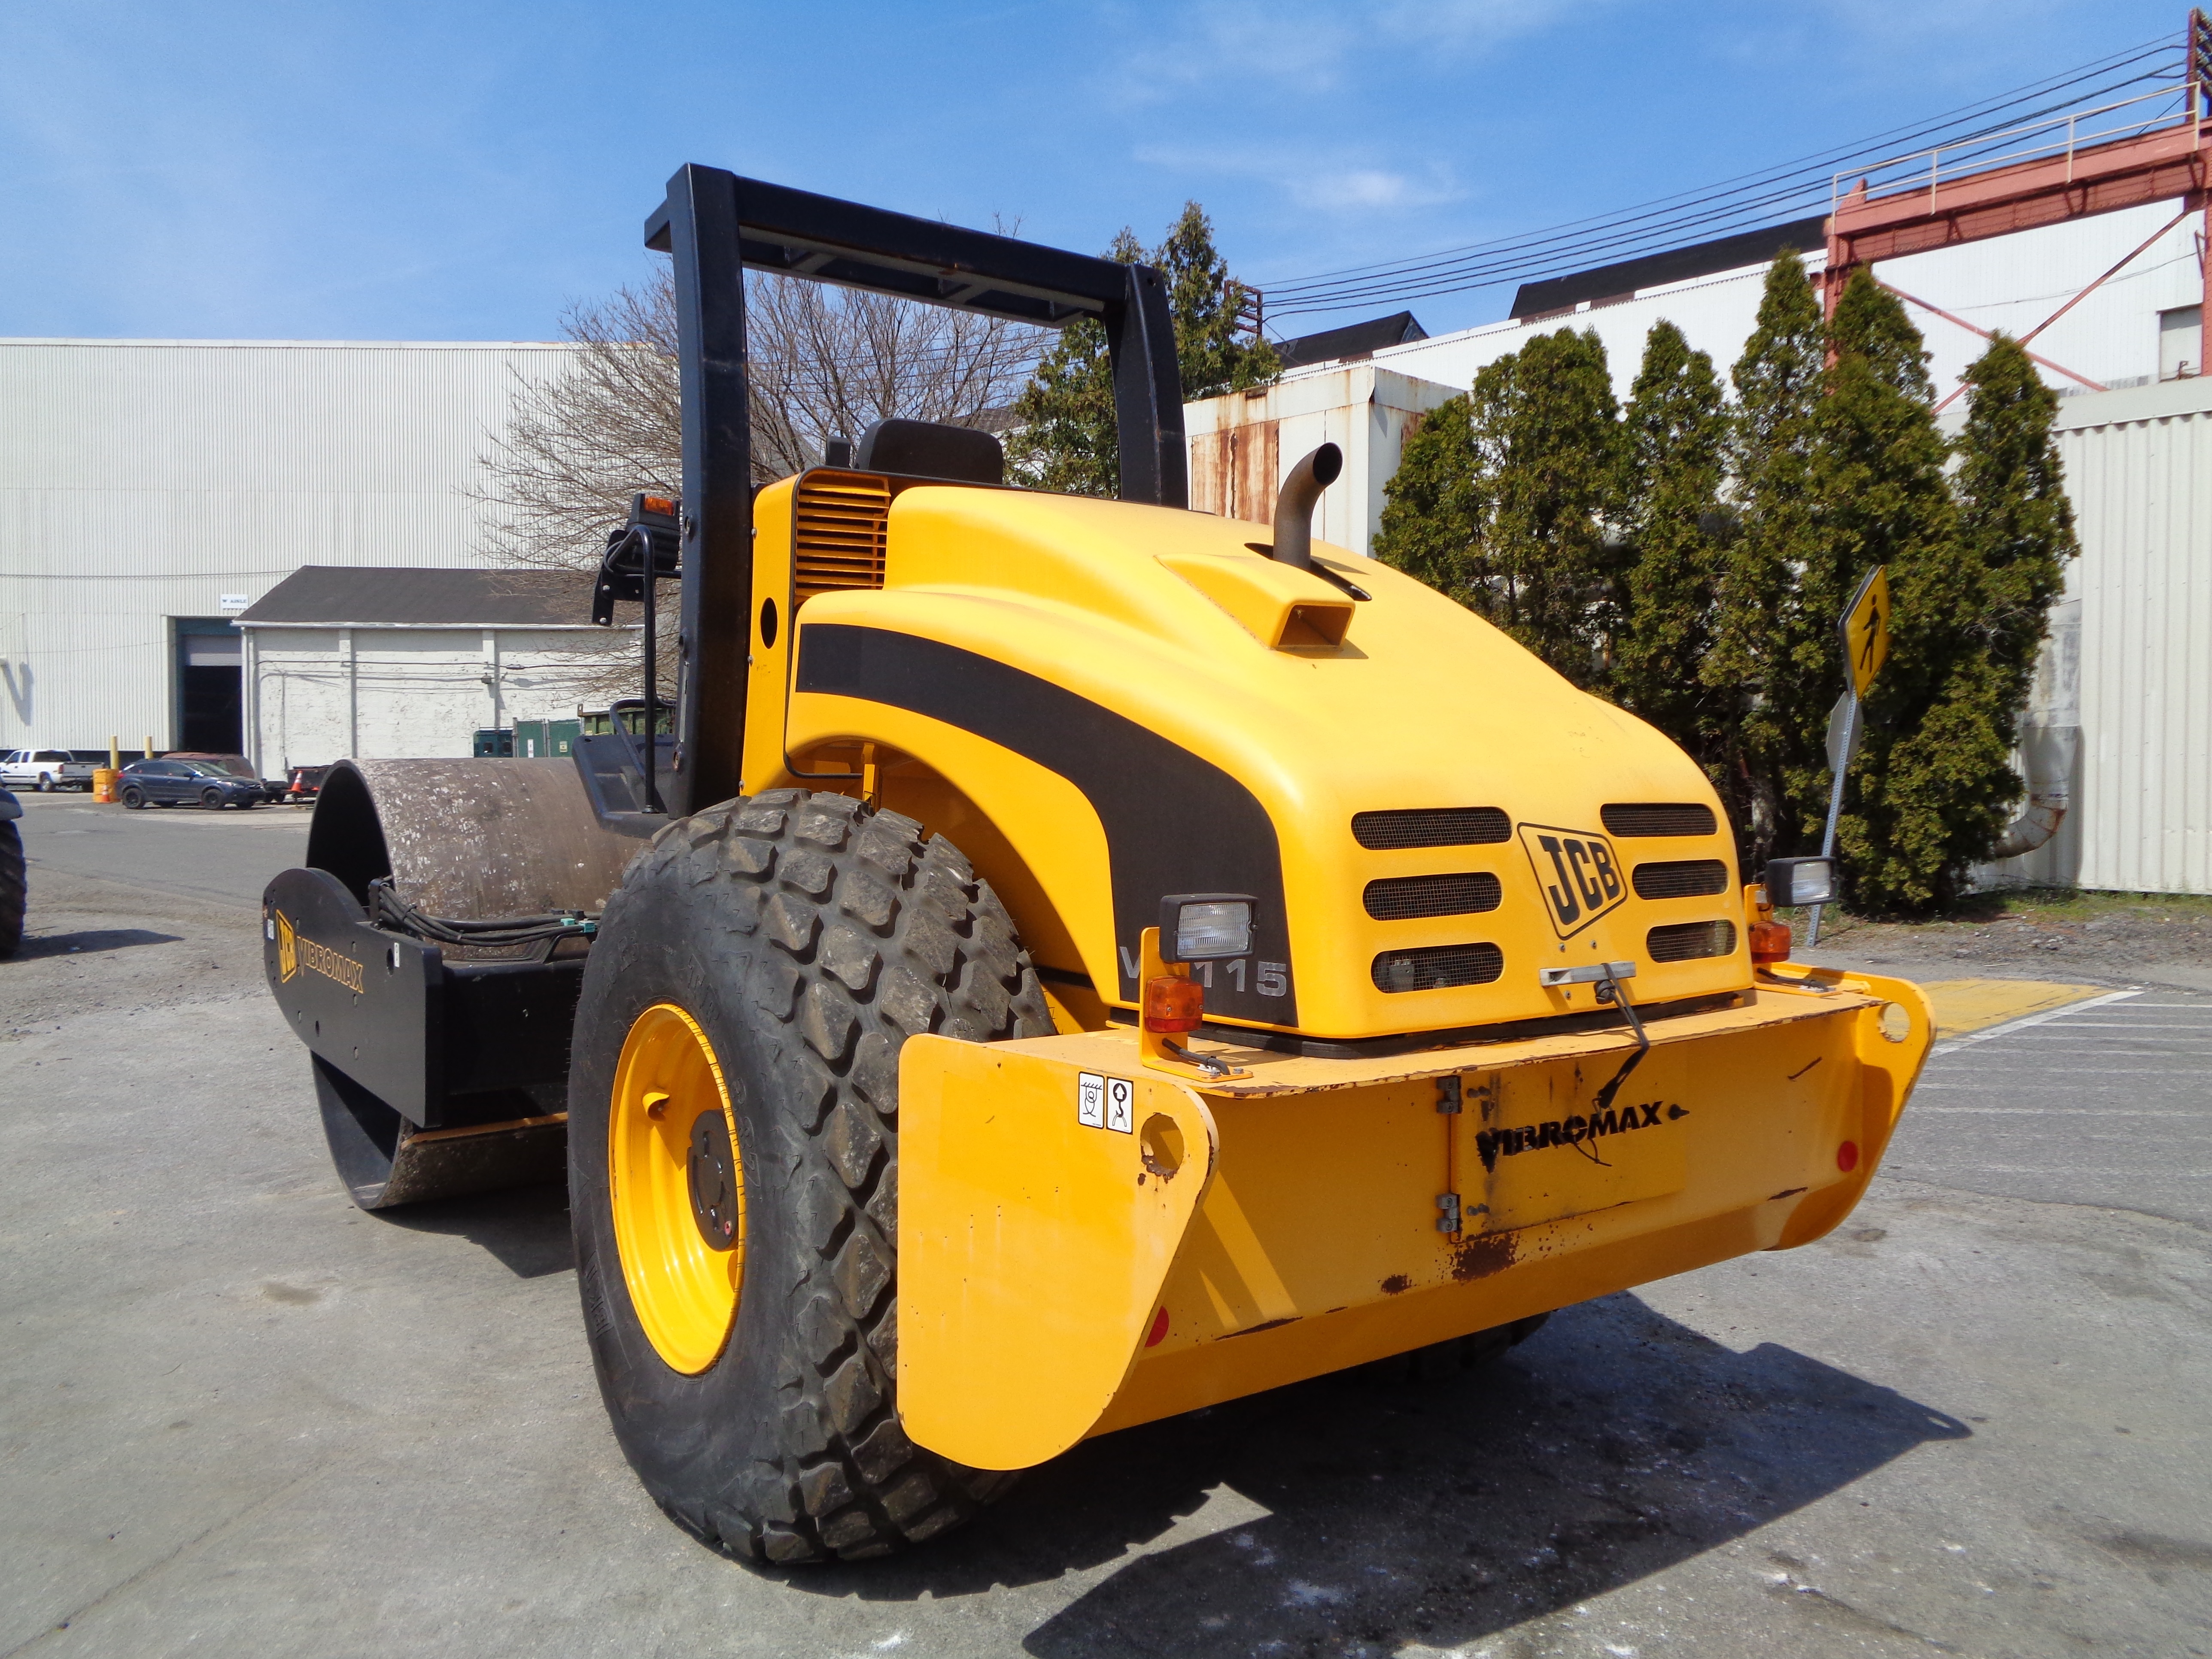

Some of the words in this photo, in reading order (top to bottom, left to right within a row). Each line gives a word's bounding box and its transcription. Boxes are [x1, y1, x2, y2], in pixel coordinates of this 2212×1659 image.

[1537, 835, 1620, 925] JCB
[296, 936, 364, 994] VIBROMAX
[1119, 946, 1286, 997] V115
[1475, 1100, 1663, 1174] VIBROMAX
